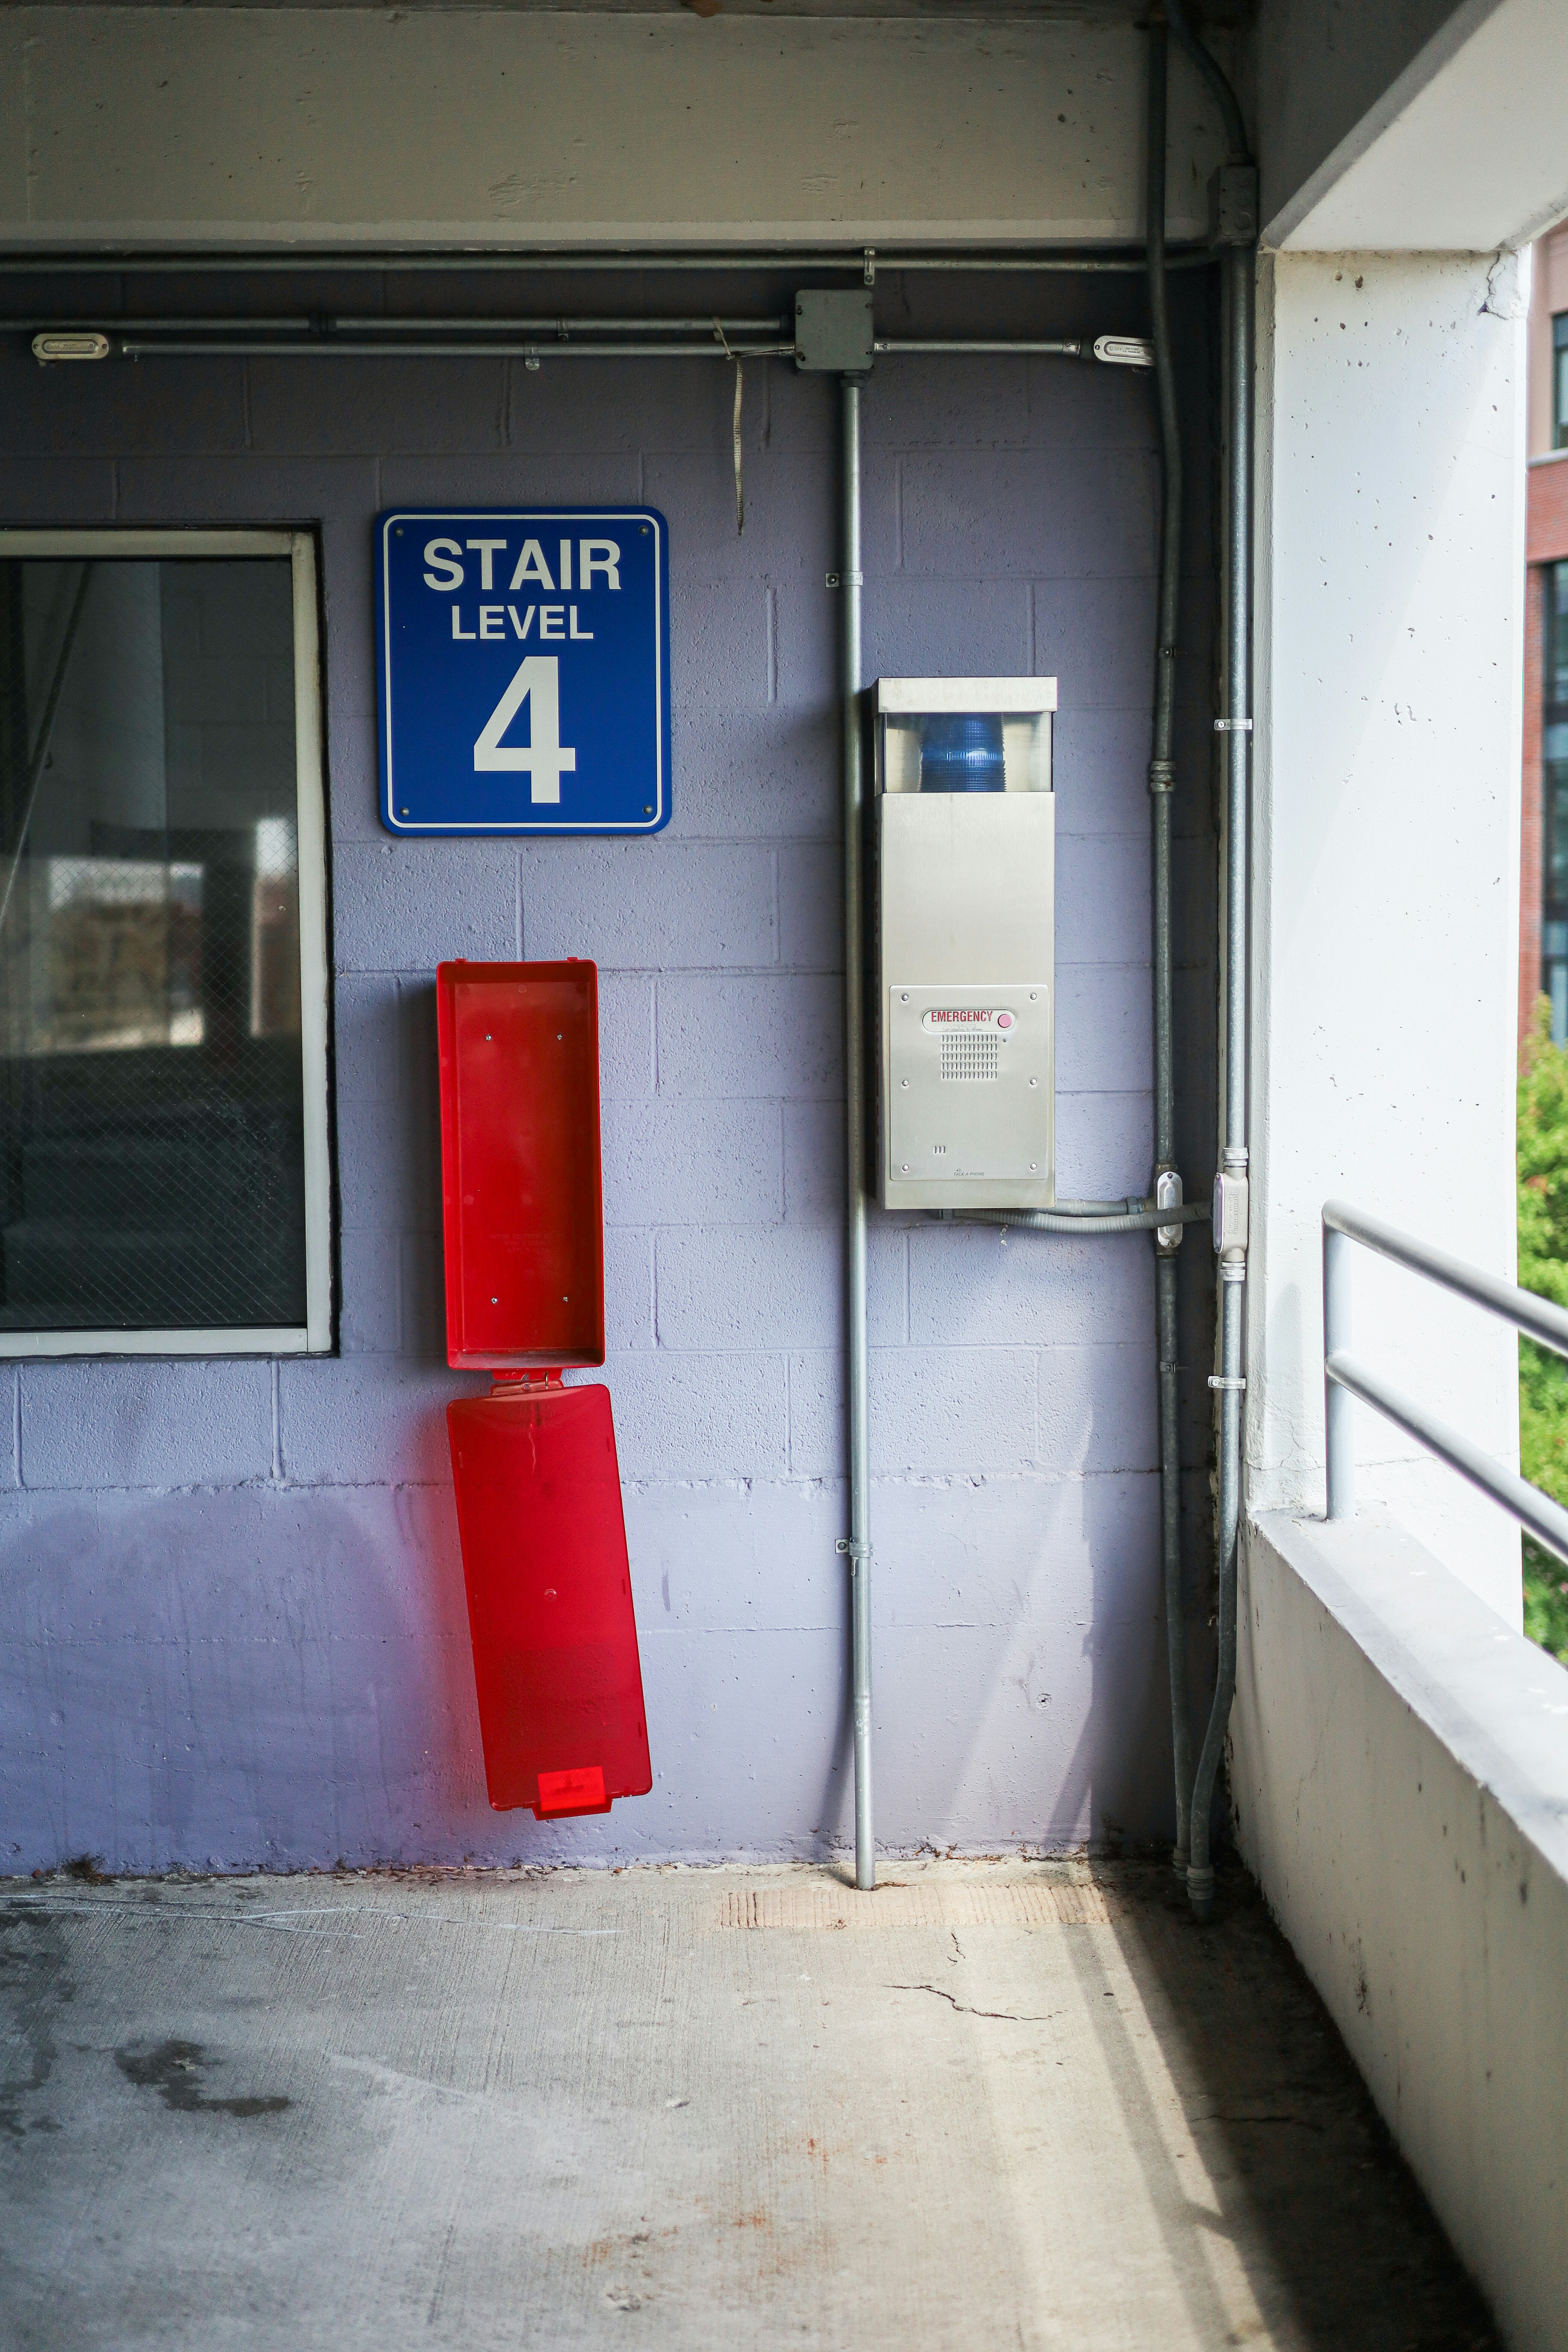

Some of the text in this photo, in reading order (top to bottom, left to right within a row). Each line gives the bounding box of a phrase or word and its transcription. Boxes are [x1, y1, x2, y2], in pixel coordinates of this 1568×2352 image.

[423, 538, 621, 591] STAIR
[452, 605, 594, 639] LEVEL
[473, 656, 576, 803] 4
[931, 1011, 993, 1022] EMERGENCY
